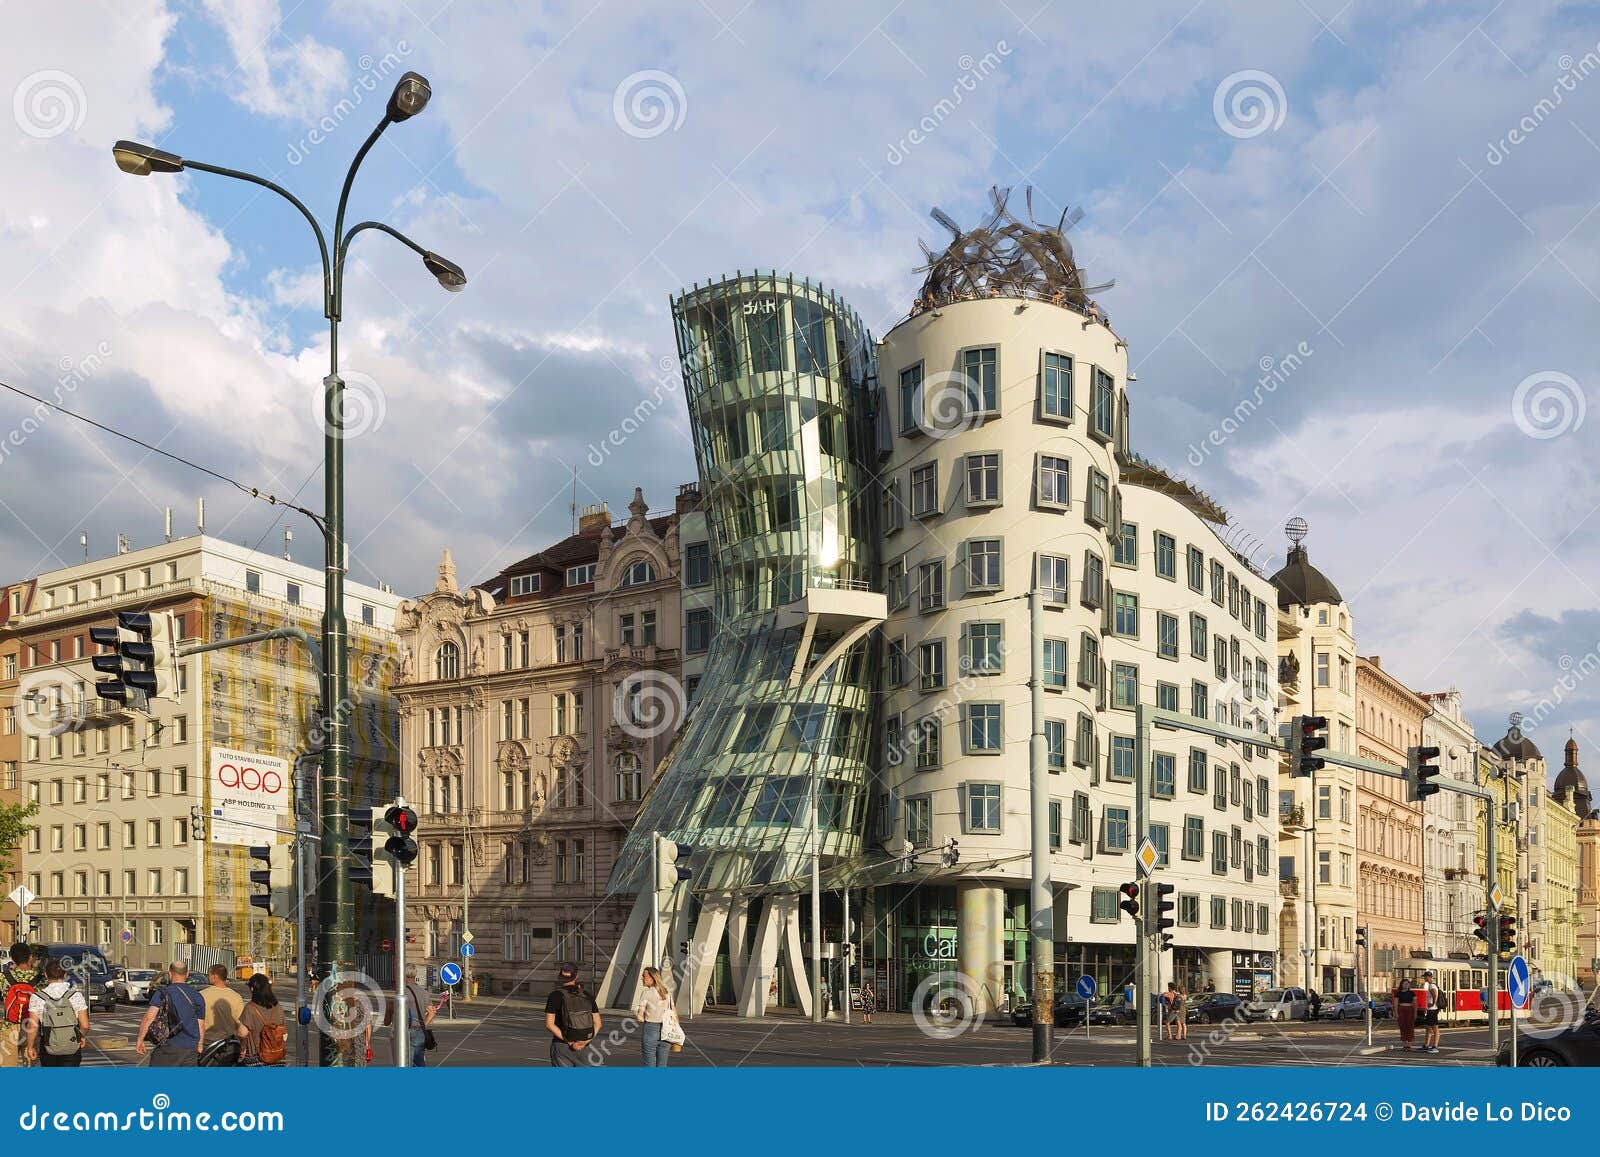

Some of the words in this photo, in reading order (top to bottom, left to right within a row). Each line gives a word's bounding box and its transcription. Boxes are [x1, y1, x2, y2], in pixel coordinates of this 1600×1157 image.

[742, 299, 777, 315] BAR
[219, 752, 234, 760] TUTO
[238, 800, 266, 809] HOLDING
